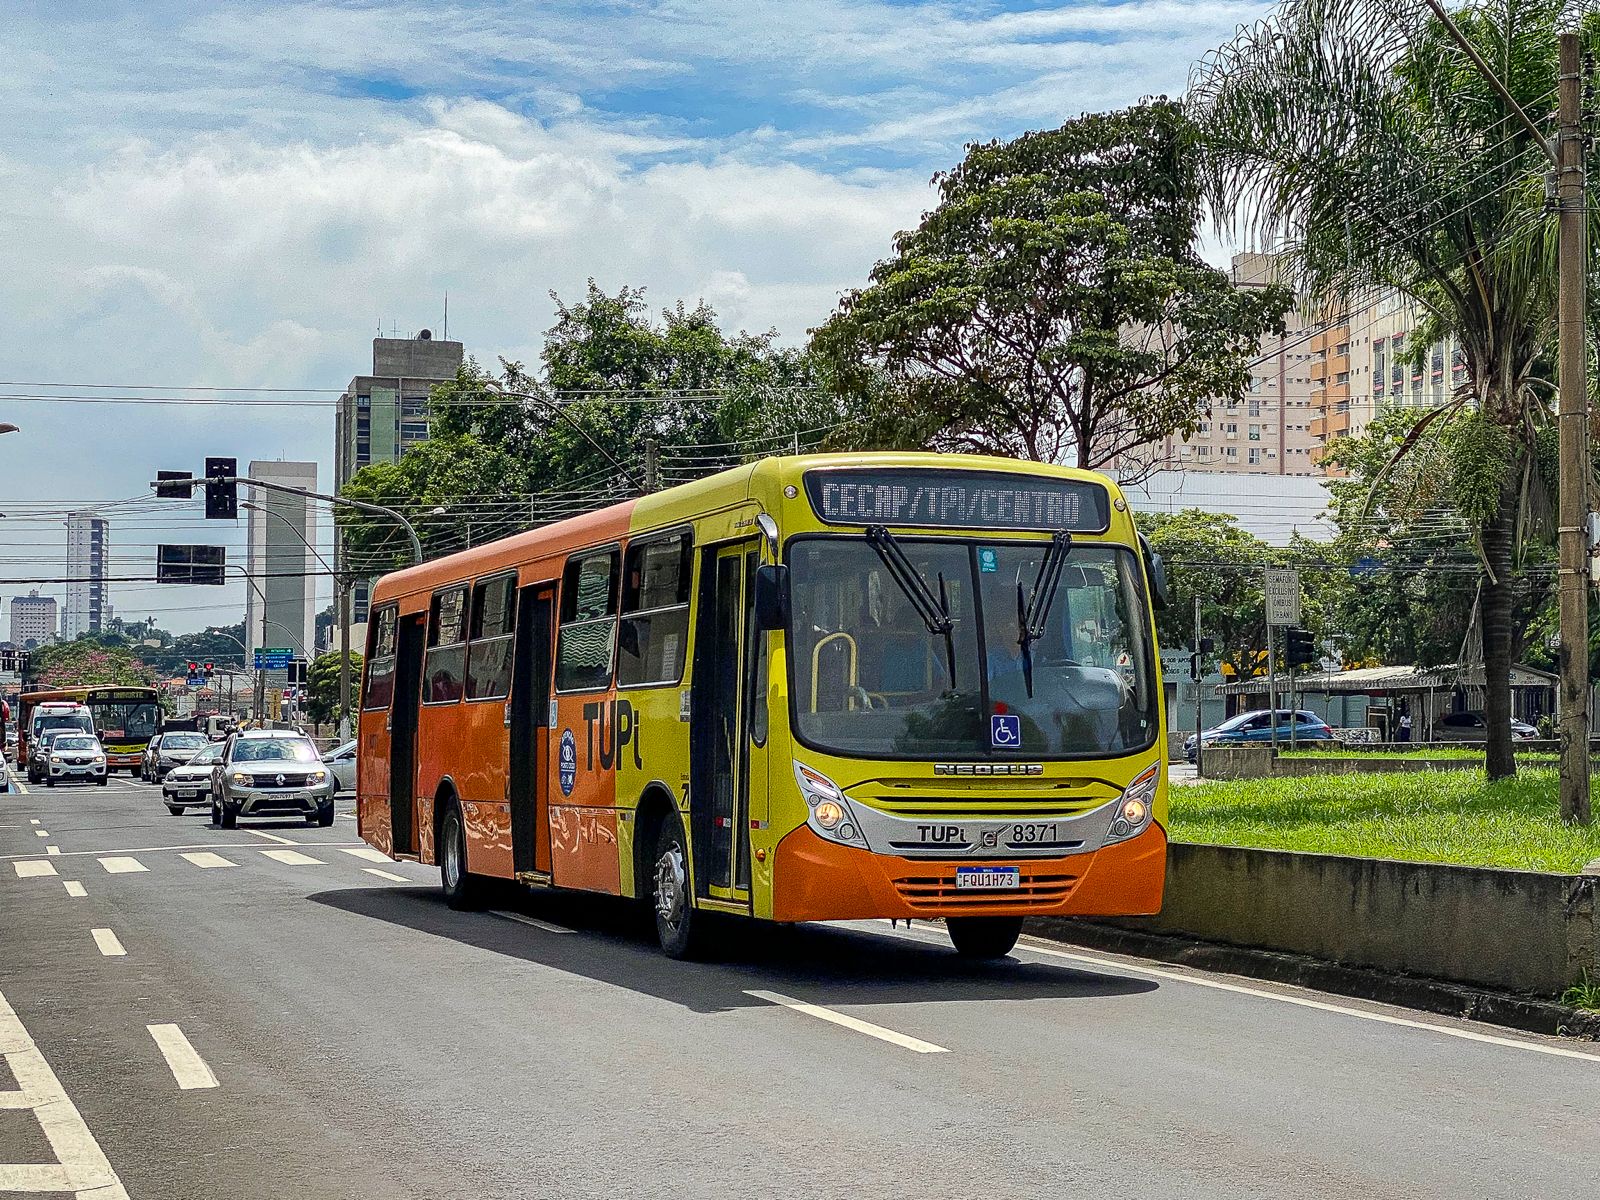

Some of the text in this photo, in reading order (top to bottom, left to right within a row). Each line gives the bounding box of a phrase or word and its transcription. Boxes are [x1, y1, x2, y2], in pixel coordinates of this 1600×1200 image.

[1268, 587, 1296, 596] EXCLUSIVO
[934, 763, 1044, 776] NEOBUS
[1012, 823, 1058, 843] 8371
[962, 874, 1014, 888] FQU1H73
